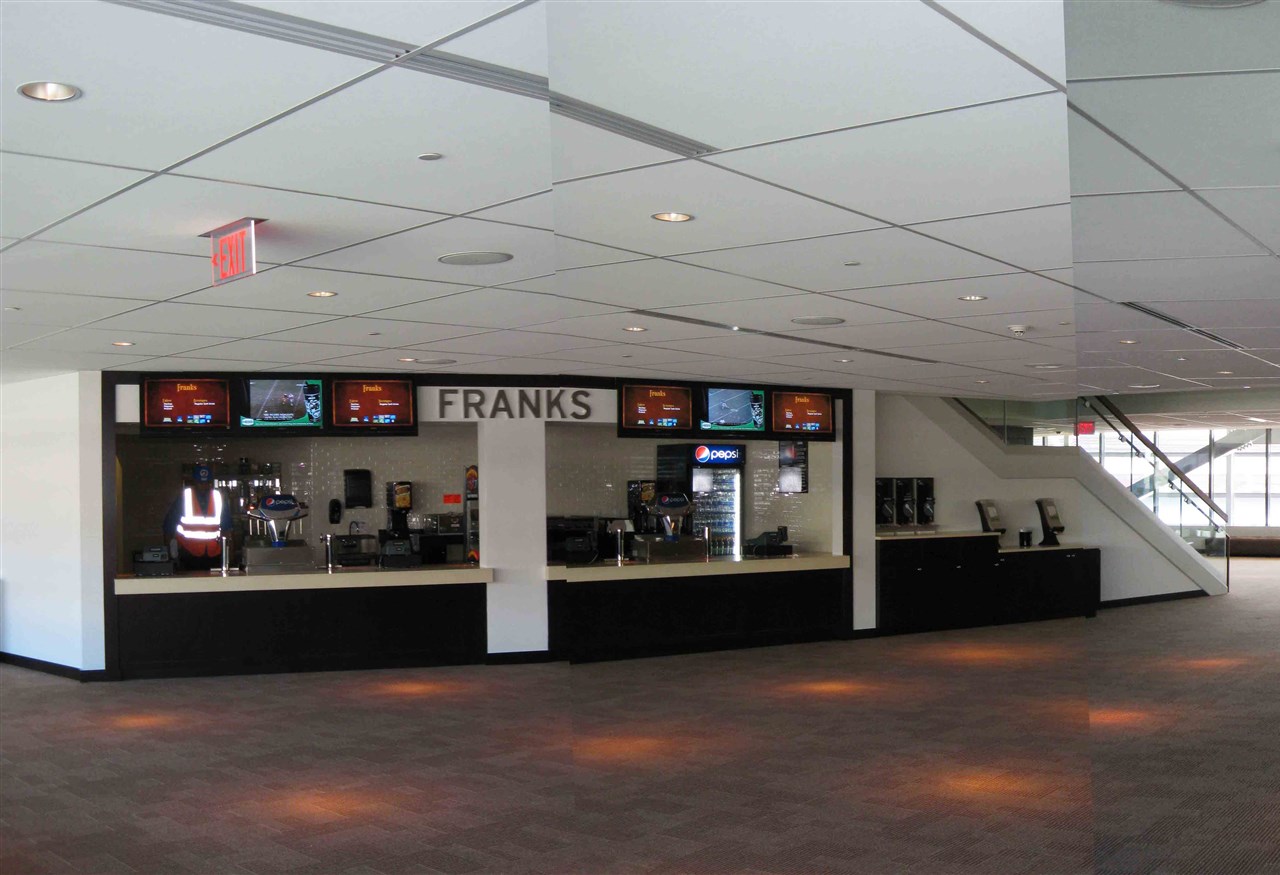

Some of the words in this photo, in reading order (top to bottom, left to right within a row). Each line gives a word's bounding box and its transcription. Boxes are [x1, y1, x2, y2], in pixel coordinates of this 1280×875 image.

[219, 229, 246, 279] EXIT
[176, 383, 197, 392] Franks
[362, 384, 382, 393] Franks
[439, 389, 591, 419] FRANKS
[710, 449, 739, 460] pepsi
